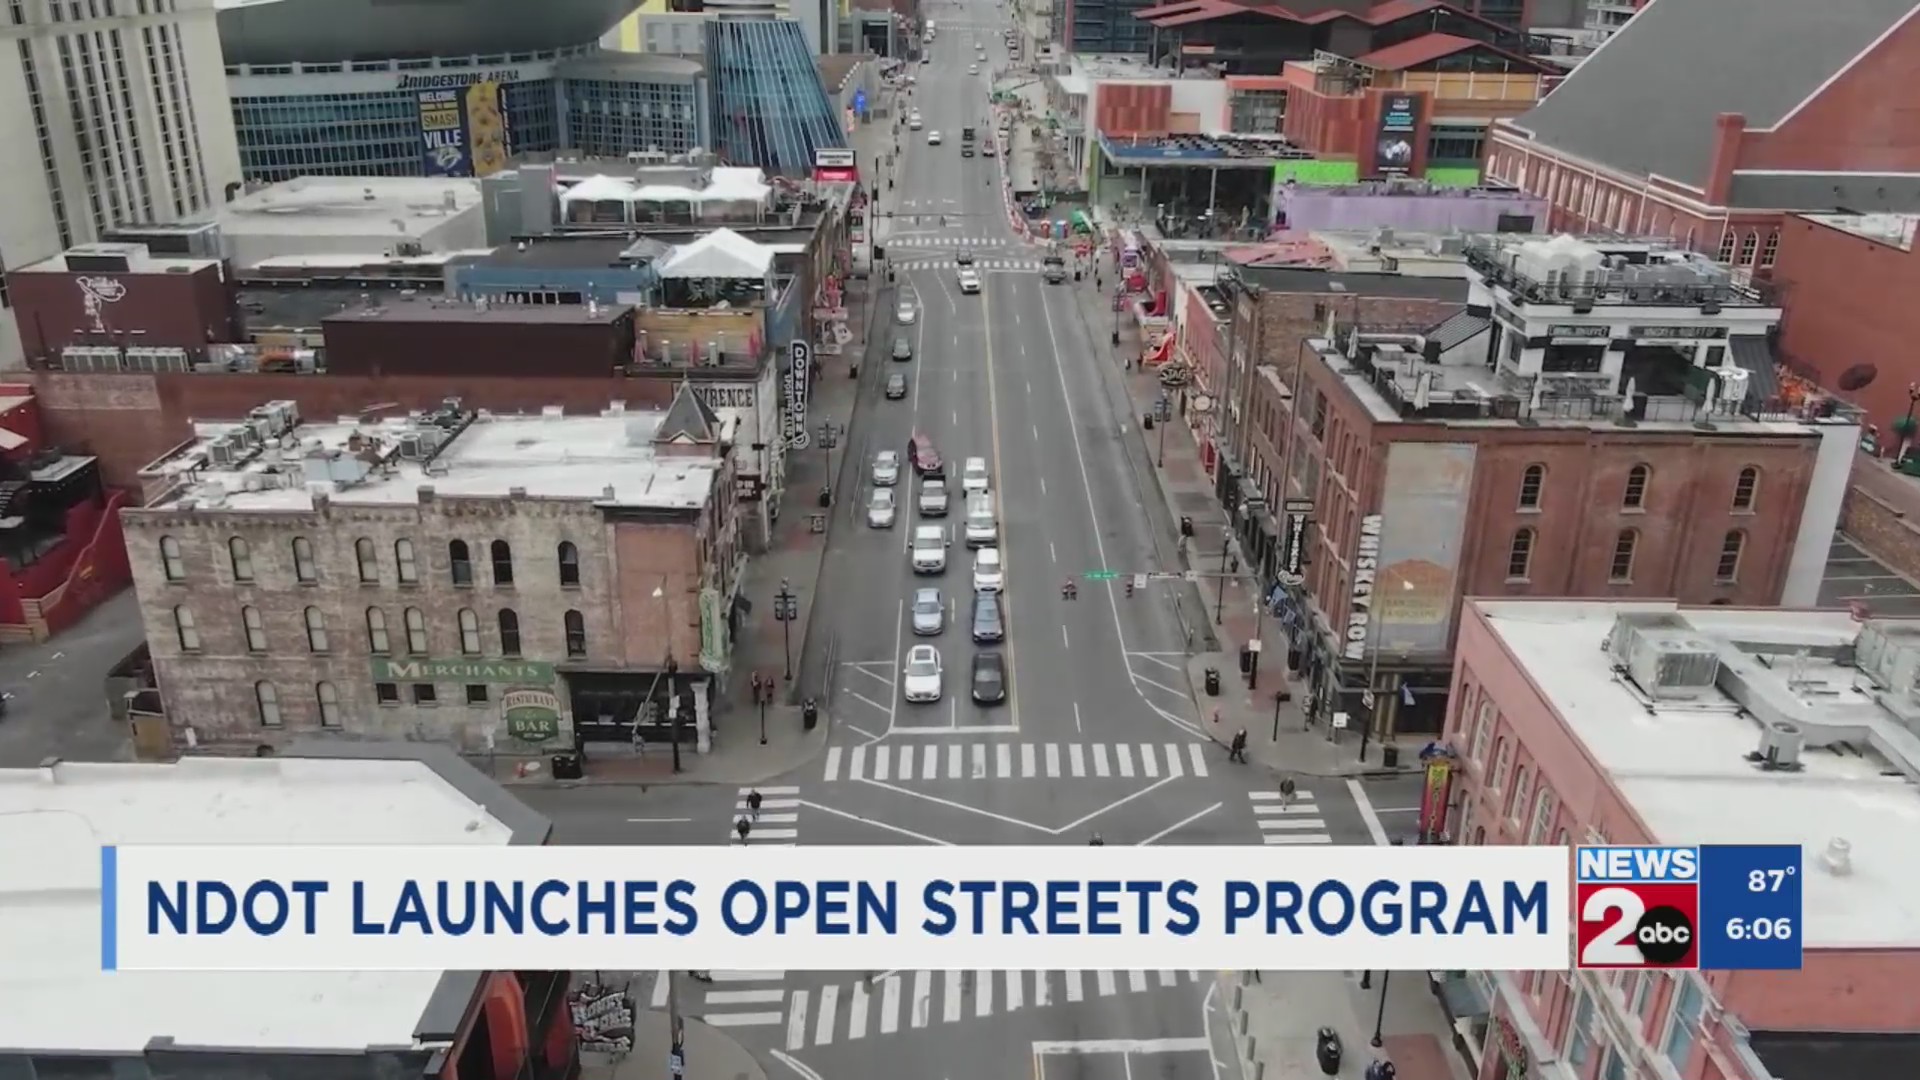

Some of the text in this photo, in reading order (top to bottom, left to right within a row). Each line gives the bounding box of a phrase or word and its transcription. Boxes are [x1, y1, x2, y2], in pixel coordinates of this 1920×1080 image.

[396, 70, 520, 89] BRIDGESTONE ARENA
[423, 114, 457, 127] SMASH
[423, 130, 463, 149] VILLE
[696, 388, 753, 408] WRENCE
[794, 346, 806, 433] DOWNTOWN
[1345, 514, 1382, 660] WHISKEY ROW
[386, 662, 539, 678] MERCHANTS
[516, 720, 550, 732] BAR
